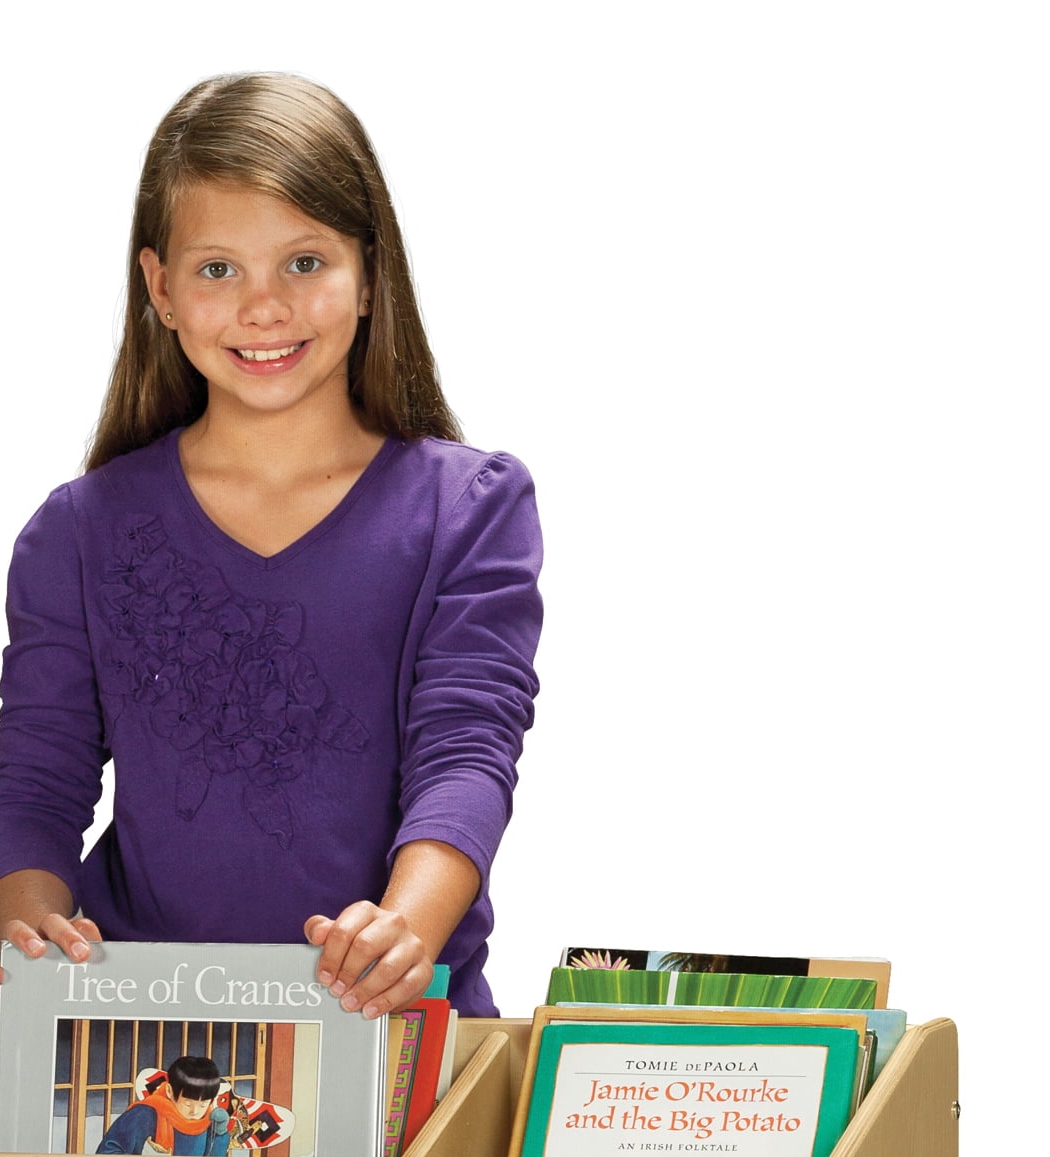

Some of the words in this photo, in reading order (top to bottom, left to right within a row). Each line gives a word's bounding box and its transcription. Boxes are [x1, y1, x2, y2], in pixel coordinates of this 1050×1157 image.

[56, 962, 137, 1004] Tree
[149, 962, 189, 1005] of
[195, 965, 323, 1008] Cranes
[625, 1060, 679, 1072] TOMIE
[583, 1079, 660, 1107] Jamie
[665, 1079, 789, 1103] O'Rourke
[565, 1105, 615, 1130] and
[621, 1106, 662, 1131] the
[668, 1109, 714, 1139] Big
[720, 1111, 801, 1133] Potato
[618, 1142, 636, 1151] AN
[640, 1143, 673, 1152] IRISH
[678, 1143, 738, 1153] FOLKTALE
